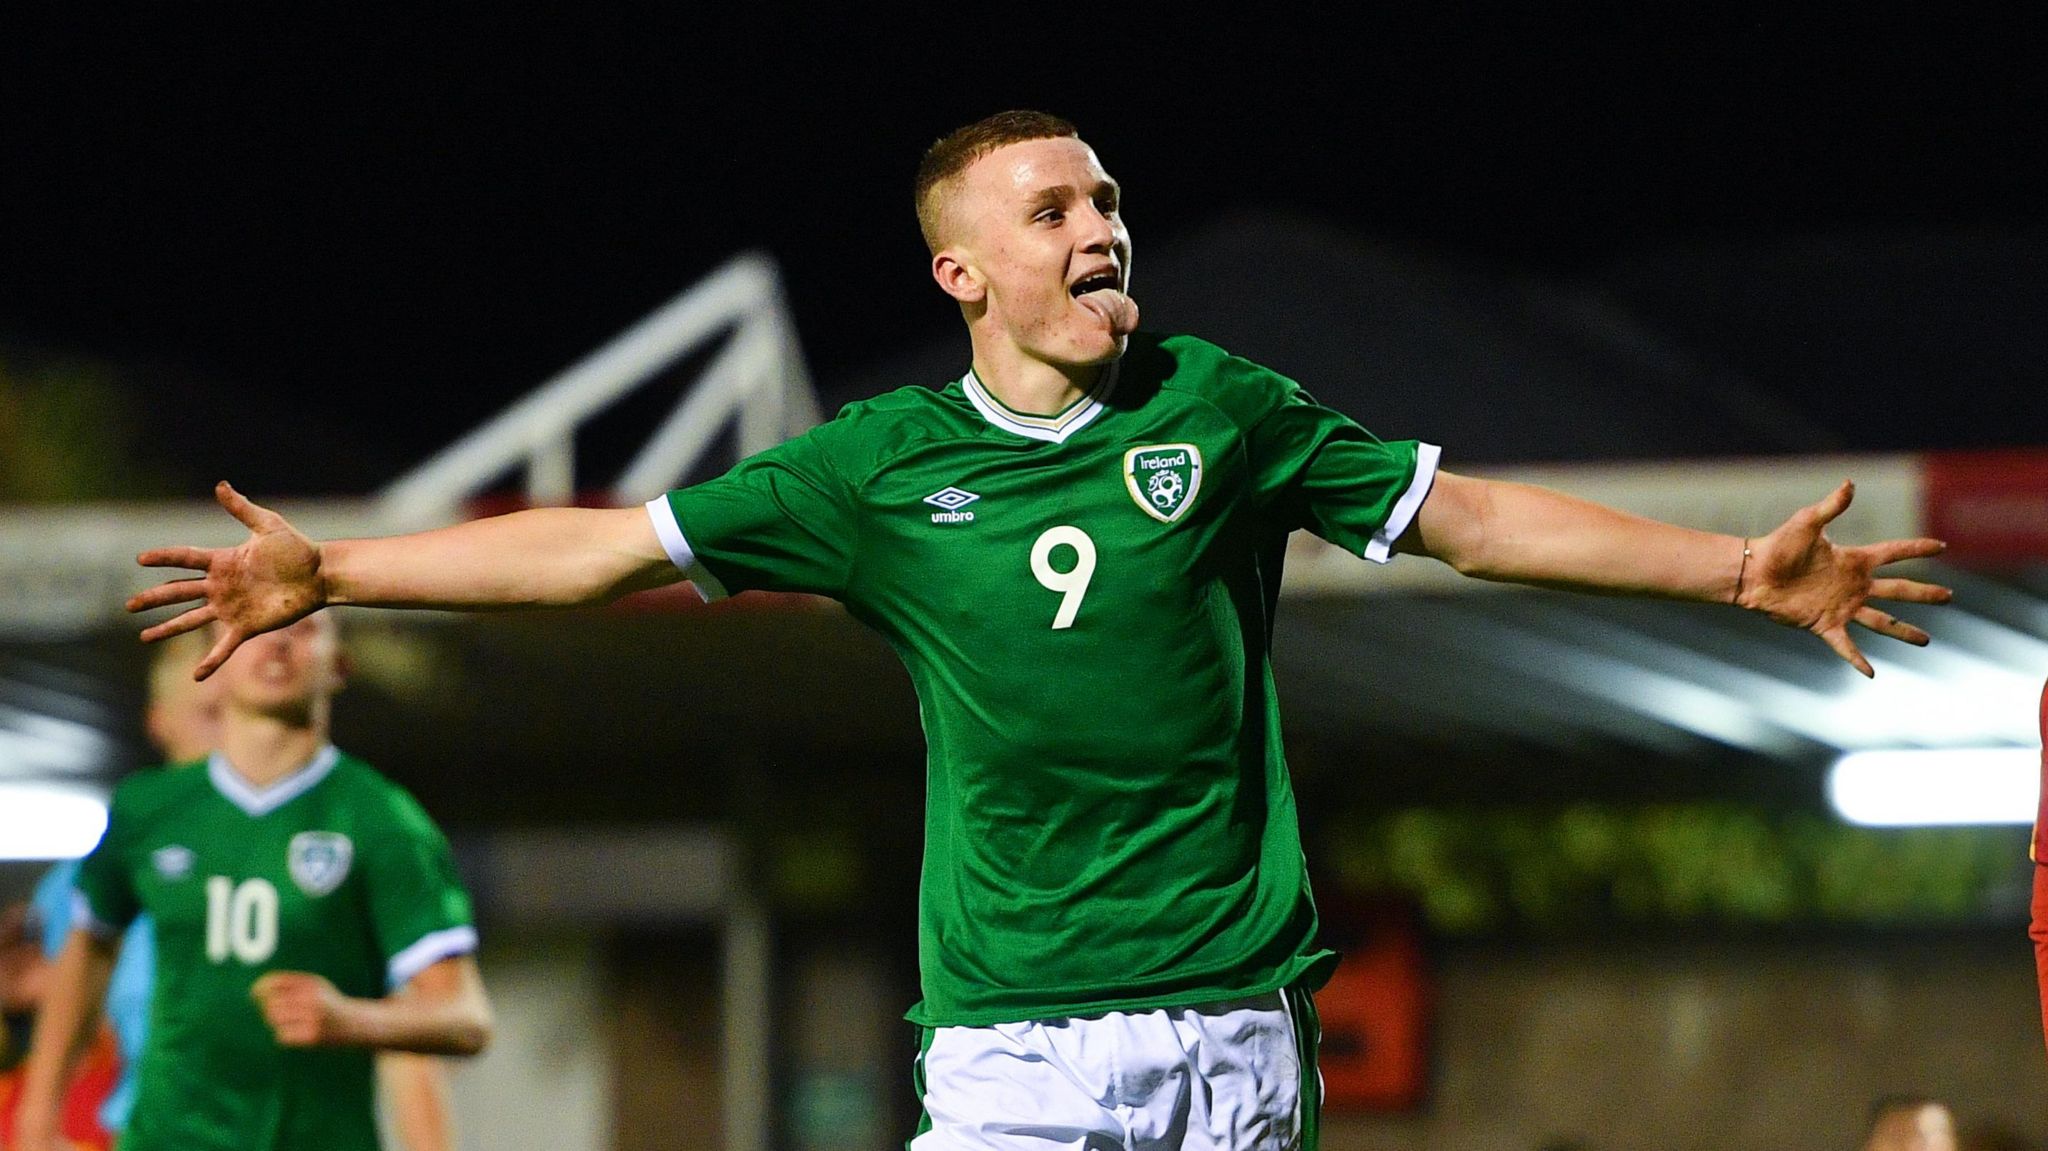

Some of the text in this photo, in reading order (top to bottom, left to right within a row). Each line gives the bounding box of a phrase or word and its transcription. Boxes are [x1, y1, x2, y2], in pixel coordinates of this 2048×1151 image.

[1140, 452, 1186, 470] Ireland
[931, 510, 974, 523] umbro
[1030, 525, 1097, 630] 9
[206, 876, 279, 965] 10
